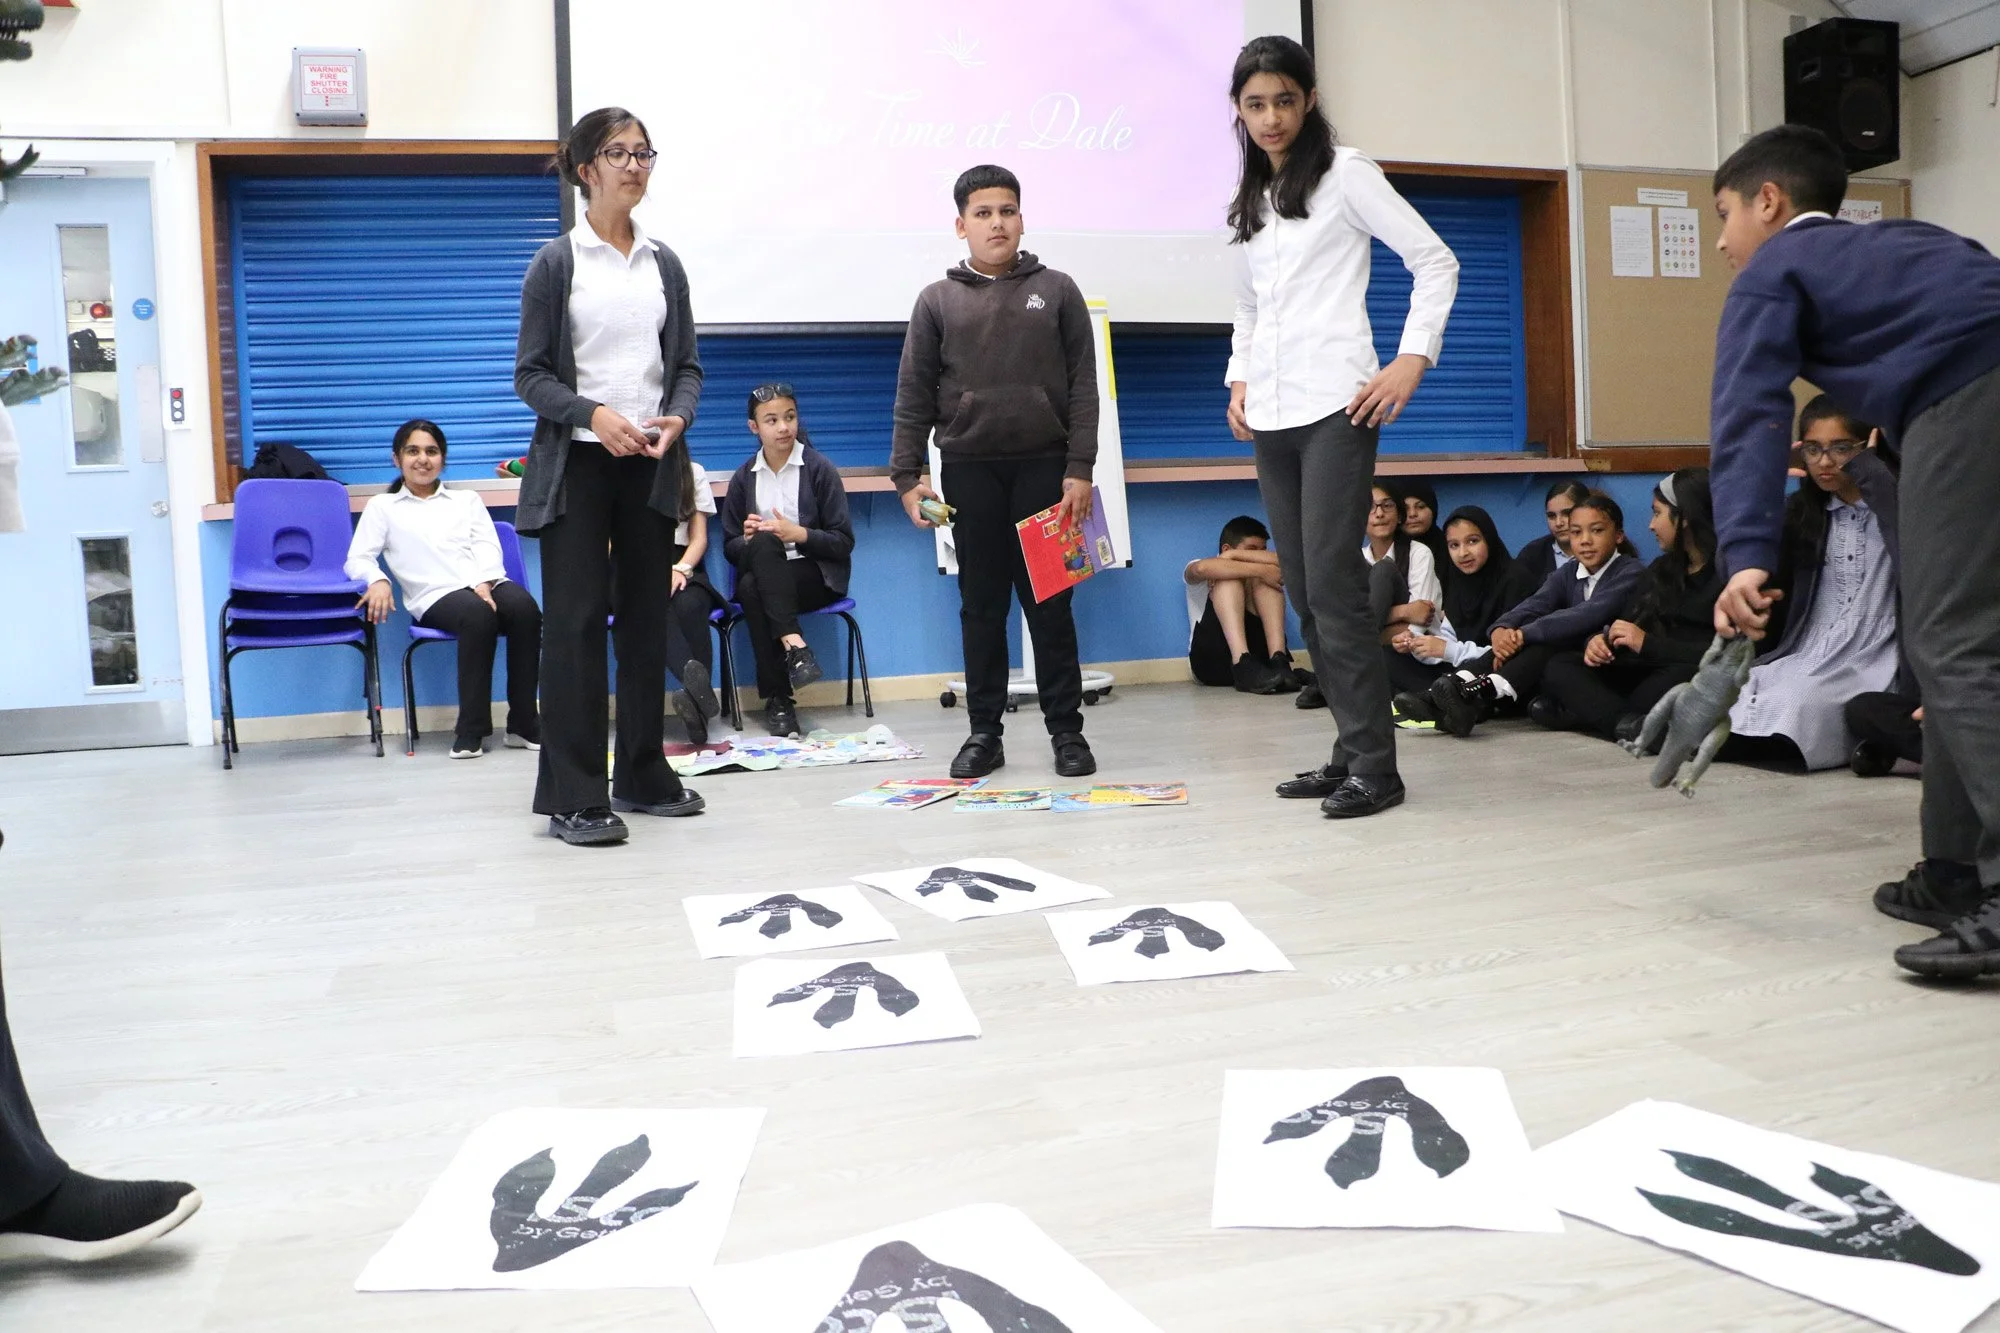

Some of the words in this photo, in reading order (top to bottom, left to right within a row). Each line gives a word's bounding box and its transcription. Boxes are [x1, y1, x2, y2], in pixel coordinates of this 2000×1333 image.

[862, 88, 955, 149] Time
[966, 110, 1012, 149] at
[1017, 92, 1132, 151] Dale
[512, 1224, 552, 1239] by
